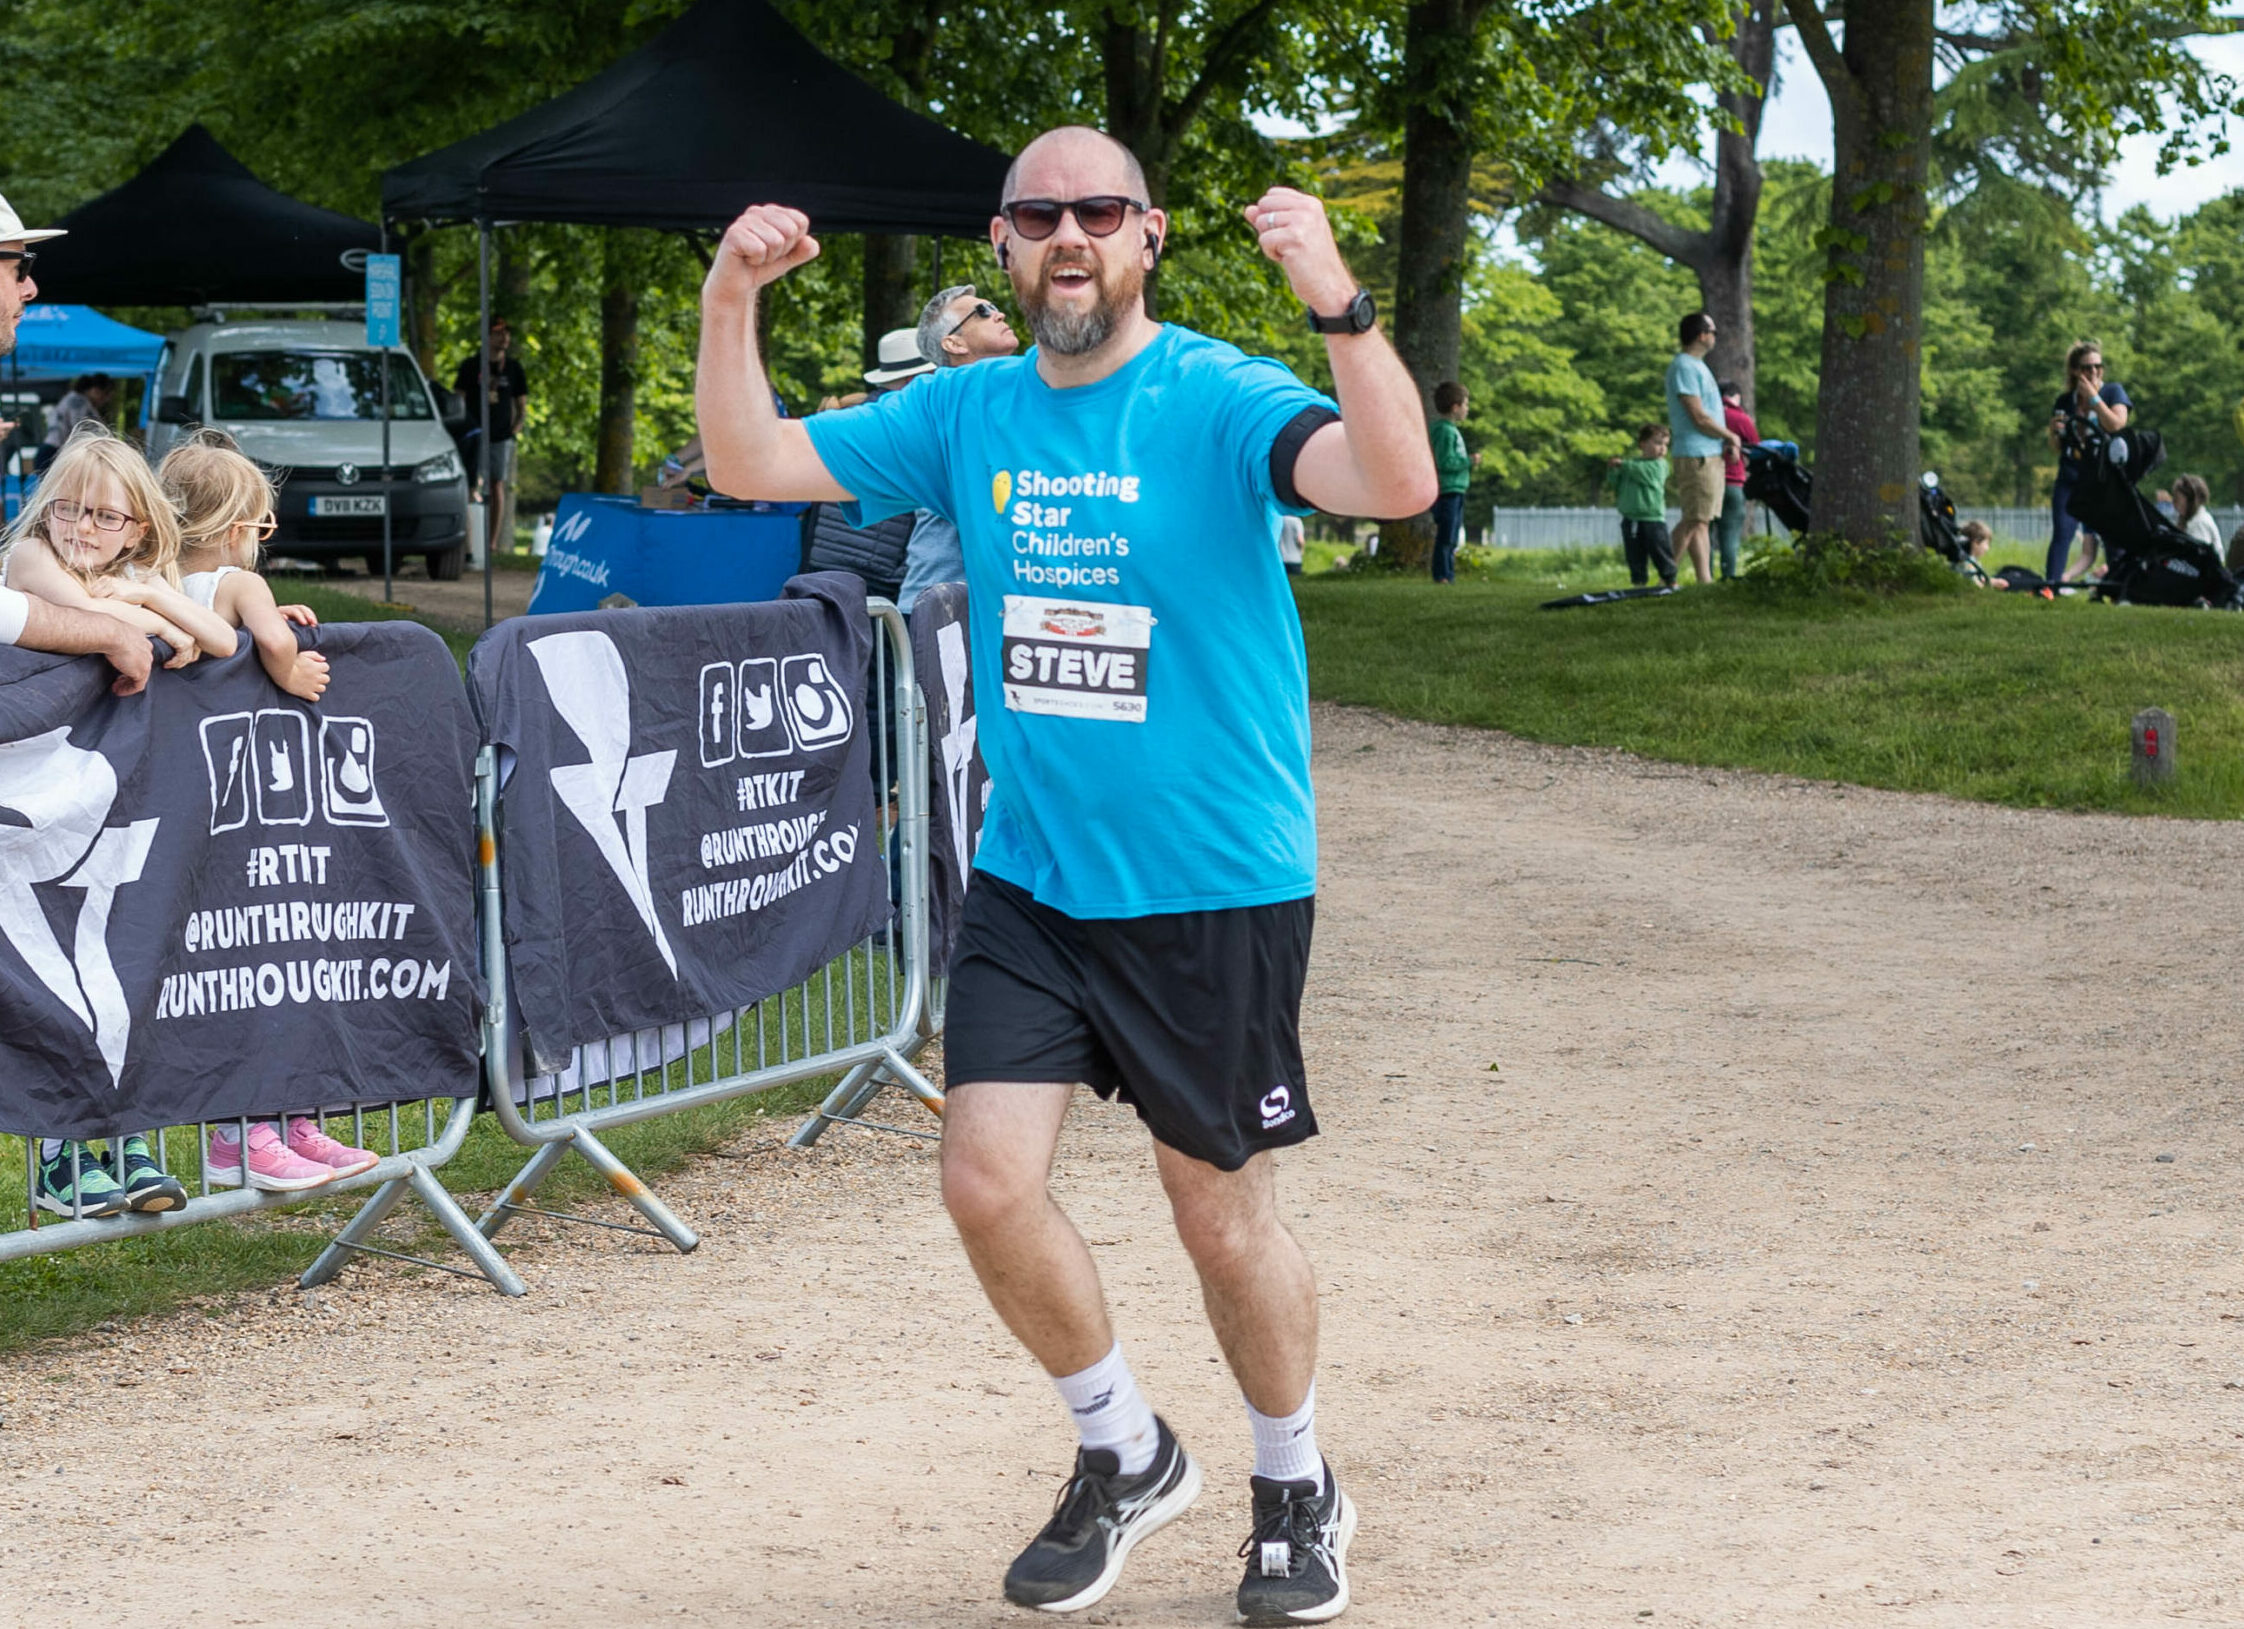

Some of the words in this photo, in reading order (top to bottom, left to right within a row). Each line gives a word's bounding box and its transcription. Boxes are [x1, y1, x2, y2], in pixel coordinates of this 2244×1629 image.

[1016, 469, 1140, 503] Shooting
[1011, 501, 1071, 528] Star
[1012, 530, 1130, 557] Children's
[1013, 559, 1120, 589] Hospices
[1009, 643, 1136, 690] STEVE
[1112, 701, 1142, 712] 5630
[737, 770, 805, 811] #RTKIT
